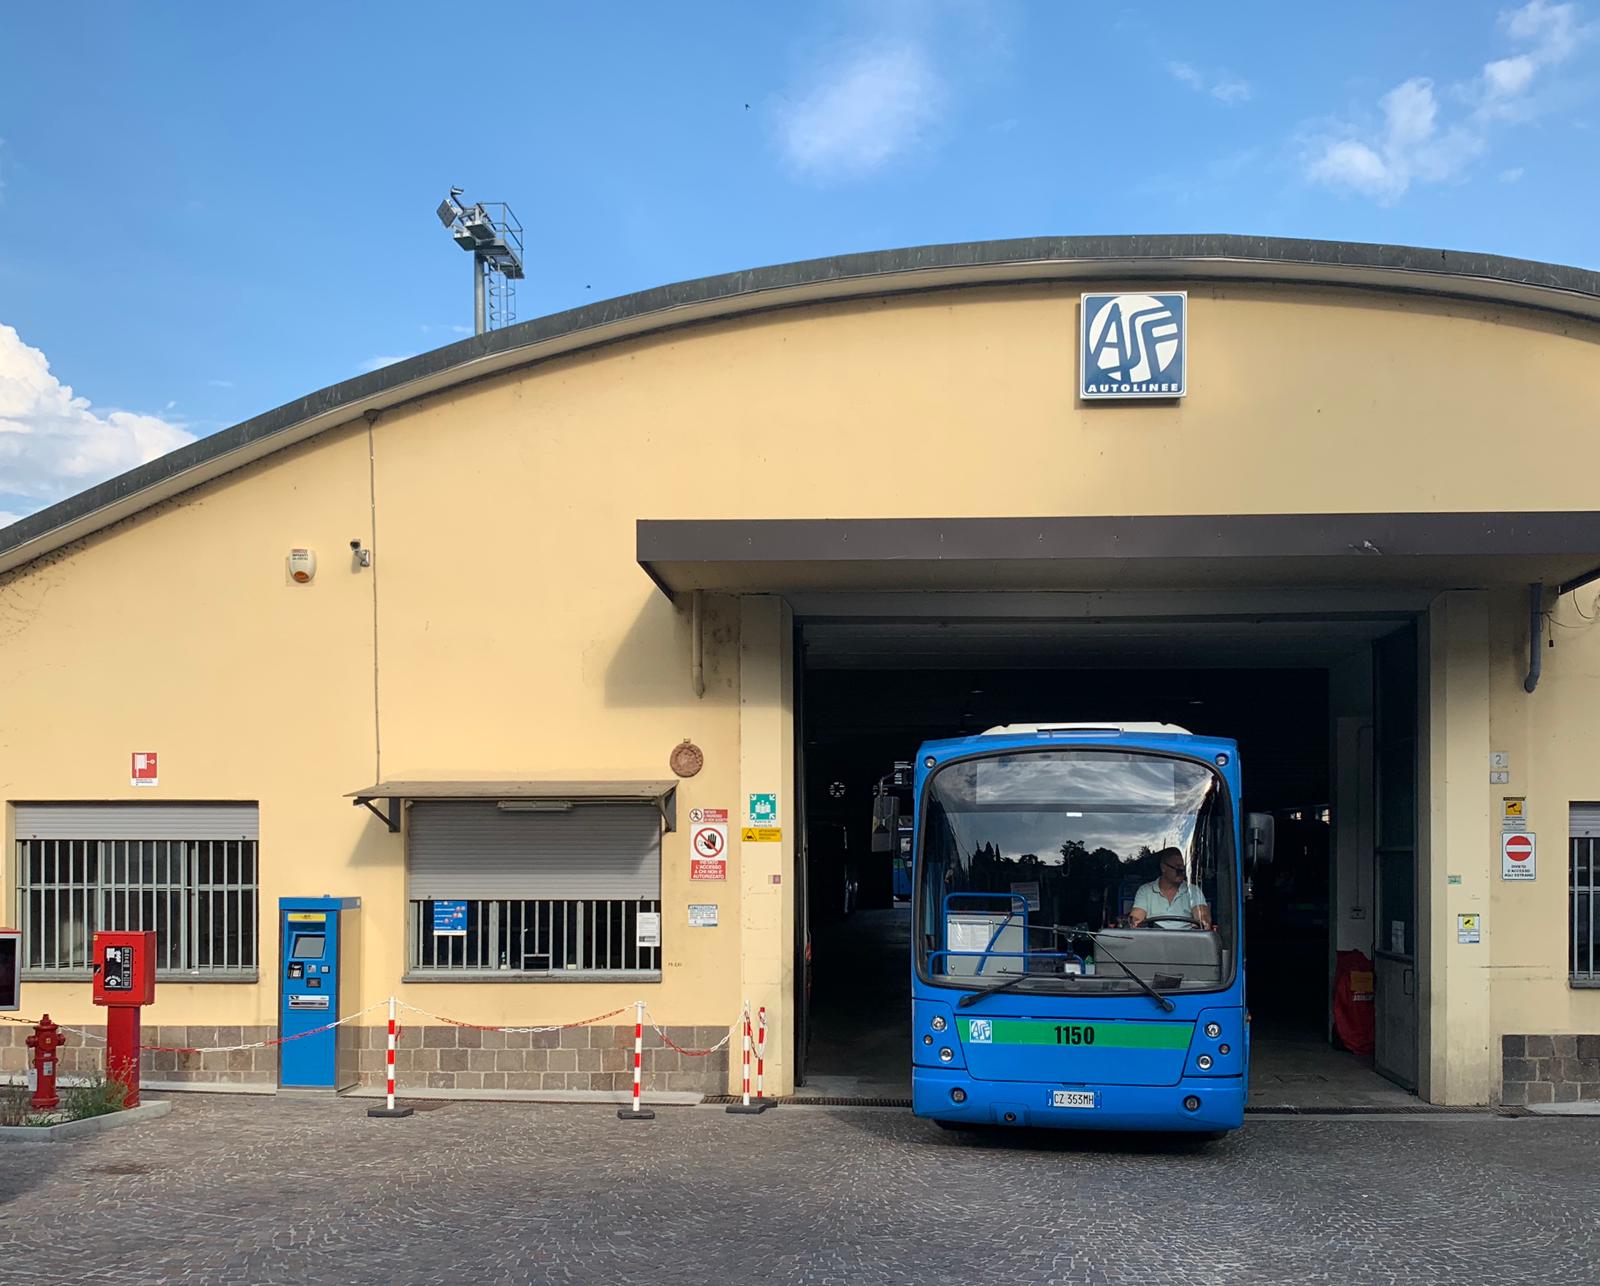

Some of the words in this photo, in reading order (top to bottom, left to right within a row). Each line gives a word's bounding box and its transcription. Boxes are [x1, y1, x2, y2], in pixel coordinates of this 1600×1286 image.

[1089, 297, 1179, 382] ASF
[1087, 383, 1179, 393] AUTOLINEE
[1495, 754, 1502, 765] 2
[1054, 1025, 1095, 1045] 1150
[1054, 1093, 1065, 1105] CZ
[1067, 1093, 1094, 1105] 353MH
